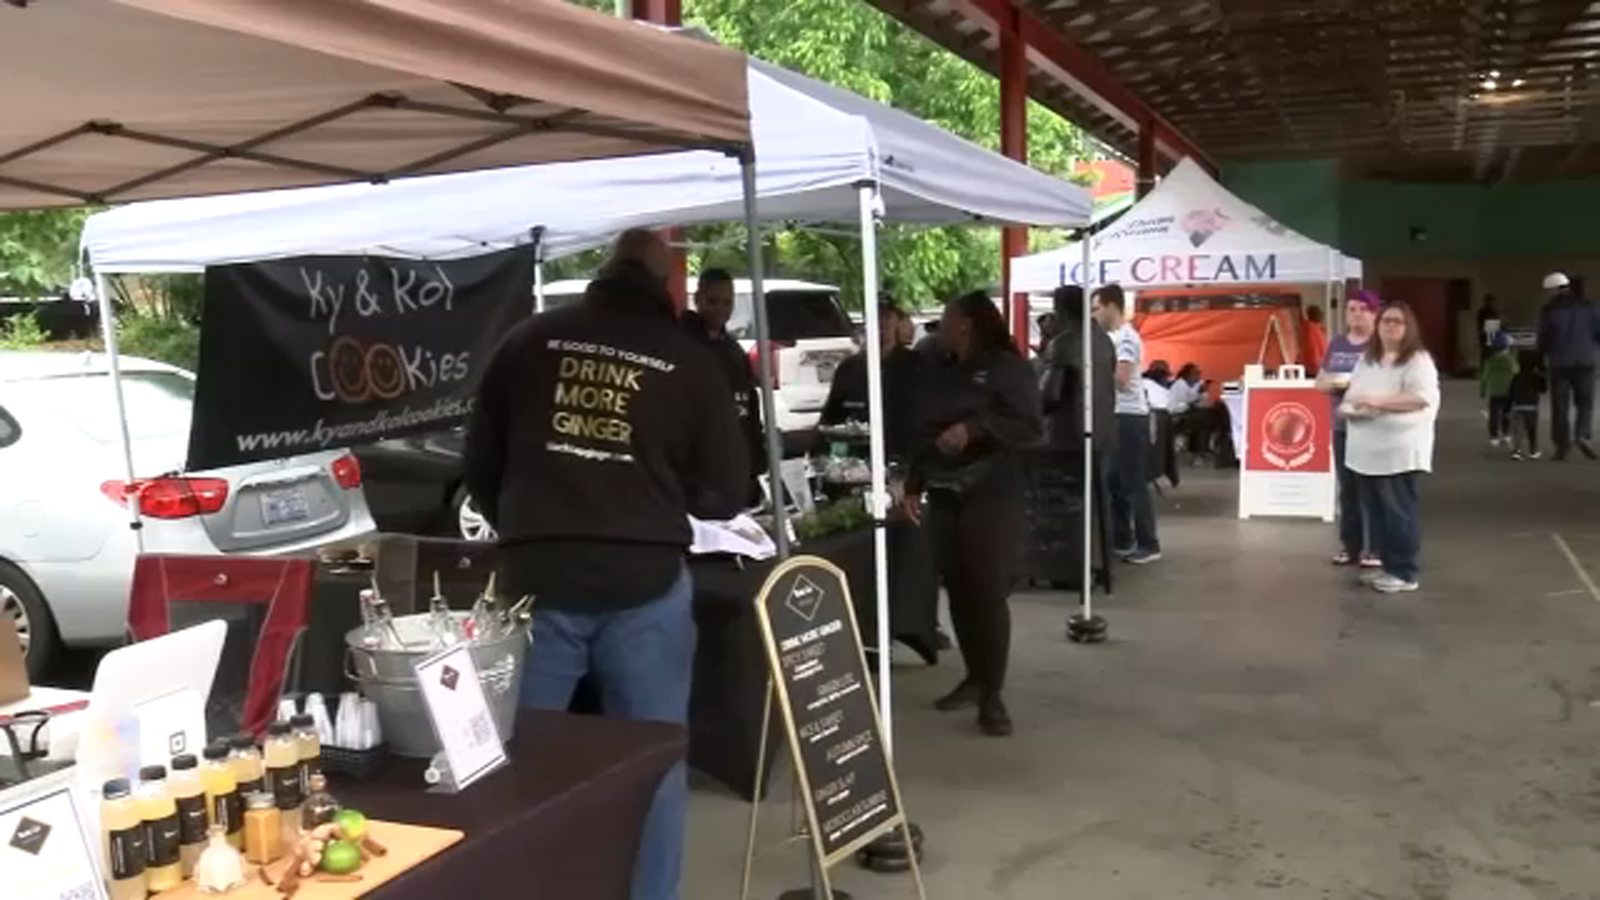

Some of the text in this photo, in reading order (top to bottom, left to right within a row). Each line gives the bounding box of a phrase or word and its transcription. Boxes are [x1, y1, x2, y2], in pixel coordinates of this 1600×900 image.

[1059, 254, 1276, 287] ICE CREAM
[302, 267, 344, 333] Ky
[355, 270, 381, 316] &
[547, 339, 676, 373] BE GOOD TO YOURSELF
[559, 357, 645, 391] DRINK
[553, 382, 631, 415] MORE
[552, 411, 633, 445] GINGER
